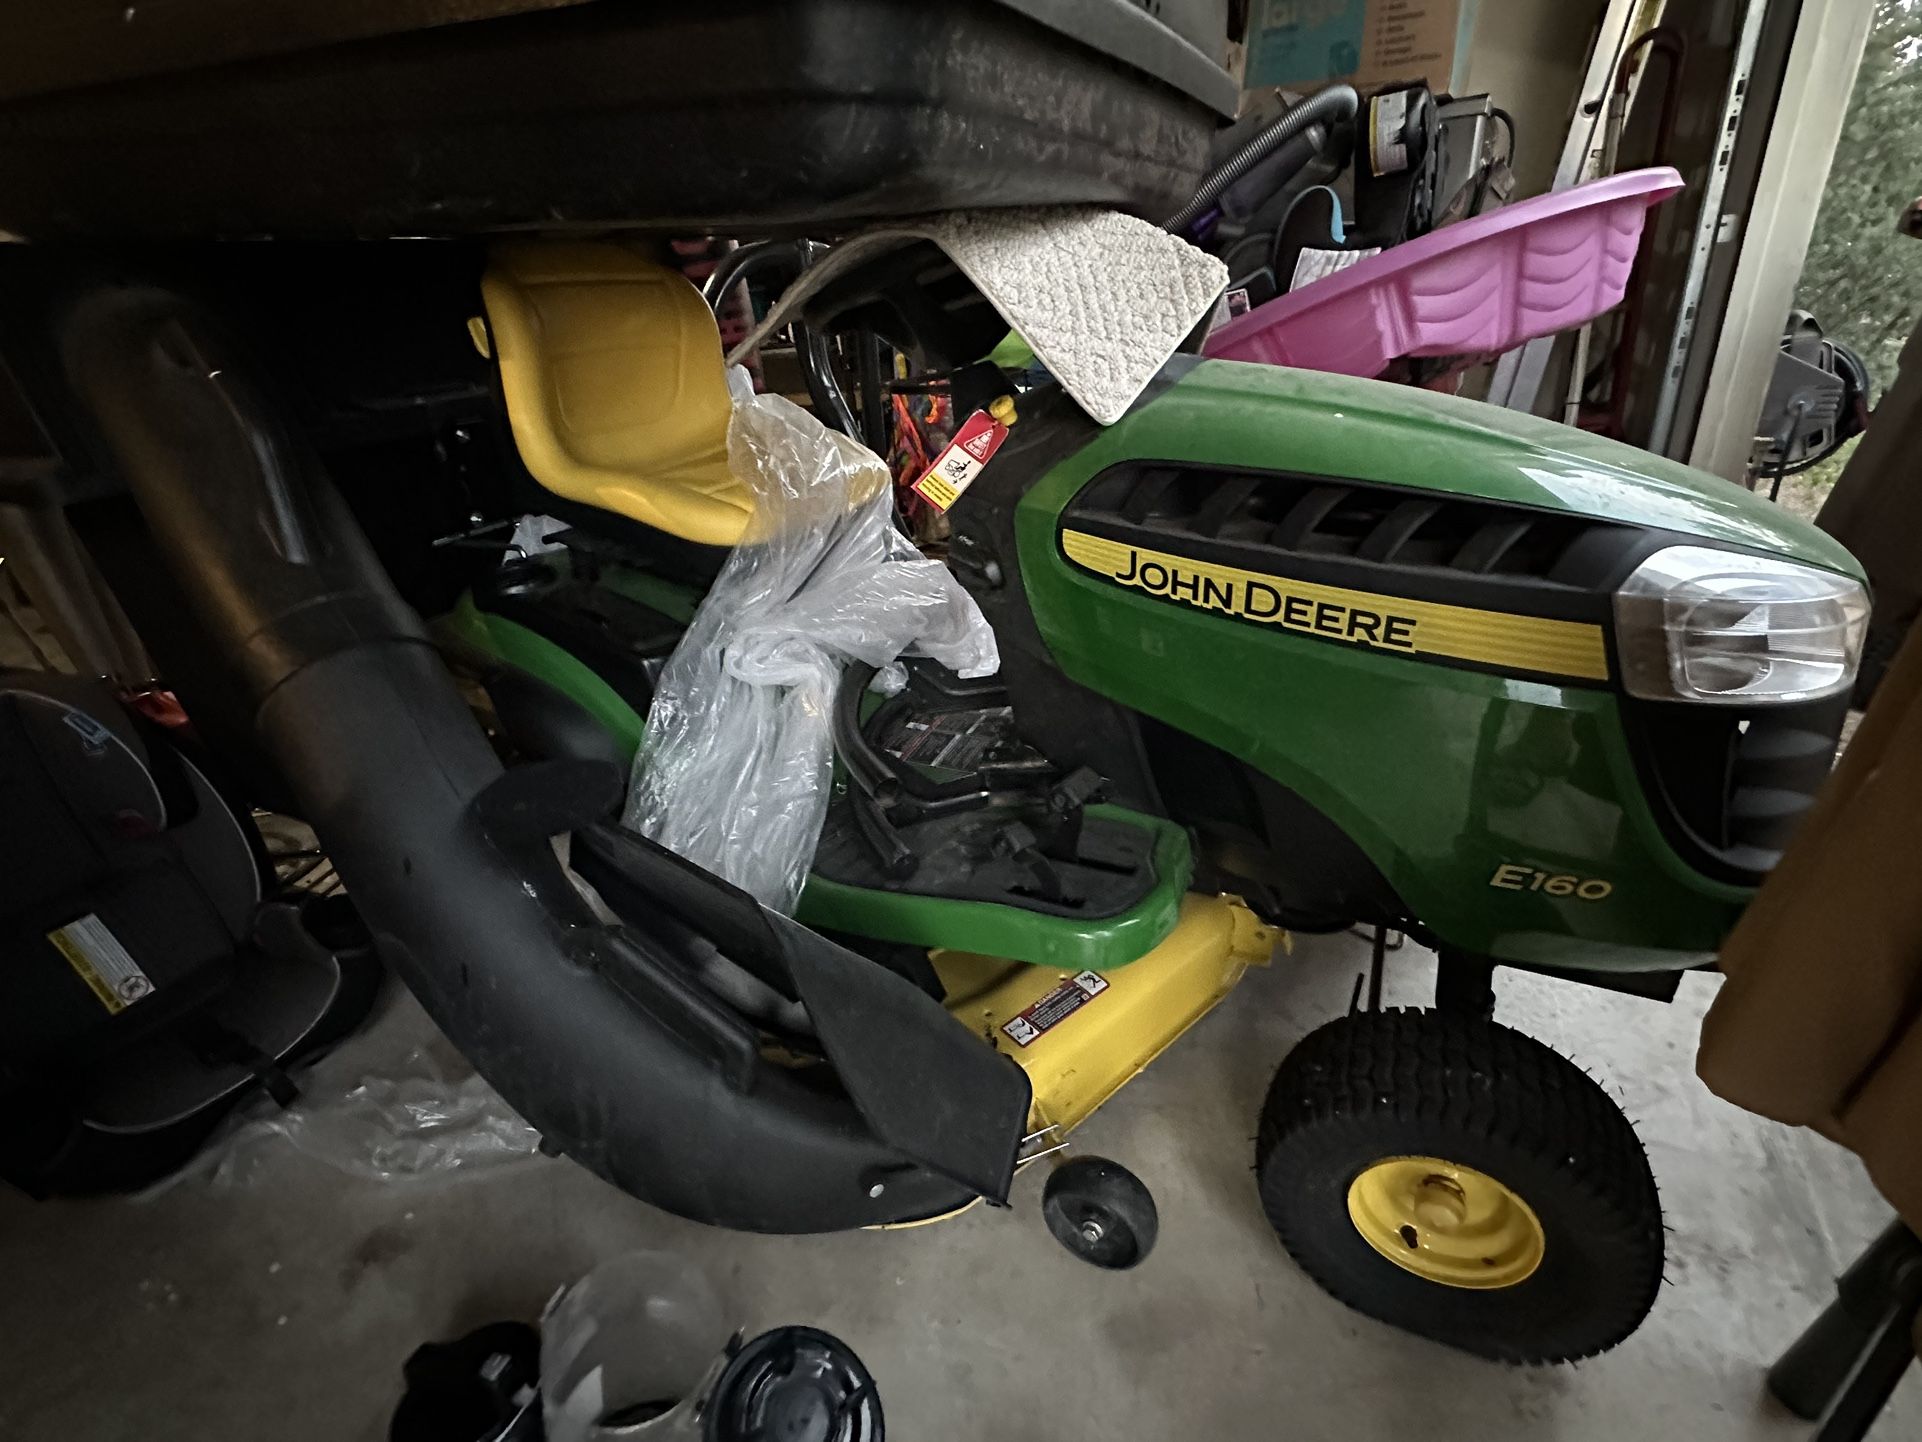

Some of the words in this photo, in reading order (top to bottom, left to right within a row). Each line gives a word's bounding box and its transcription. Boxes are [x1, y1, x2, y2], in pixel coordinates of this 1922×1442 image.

[1115, 550, 1233, 610] JOHN
[1244, 580, 1417, 648] DEERE
[1489, 864, 1613, 900] E160
